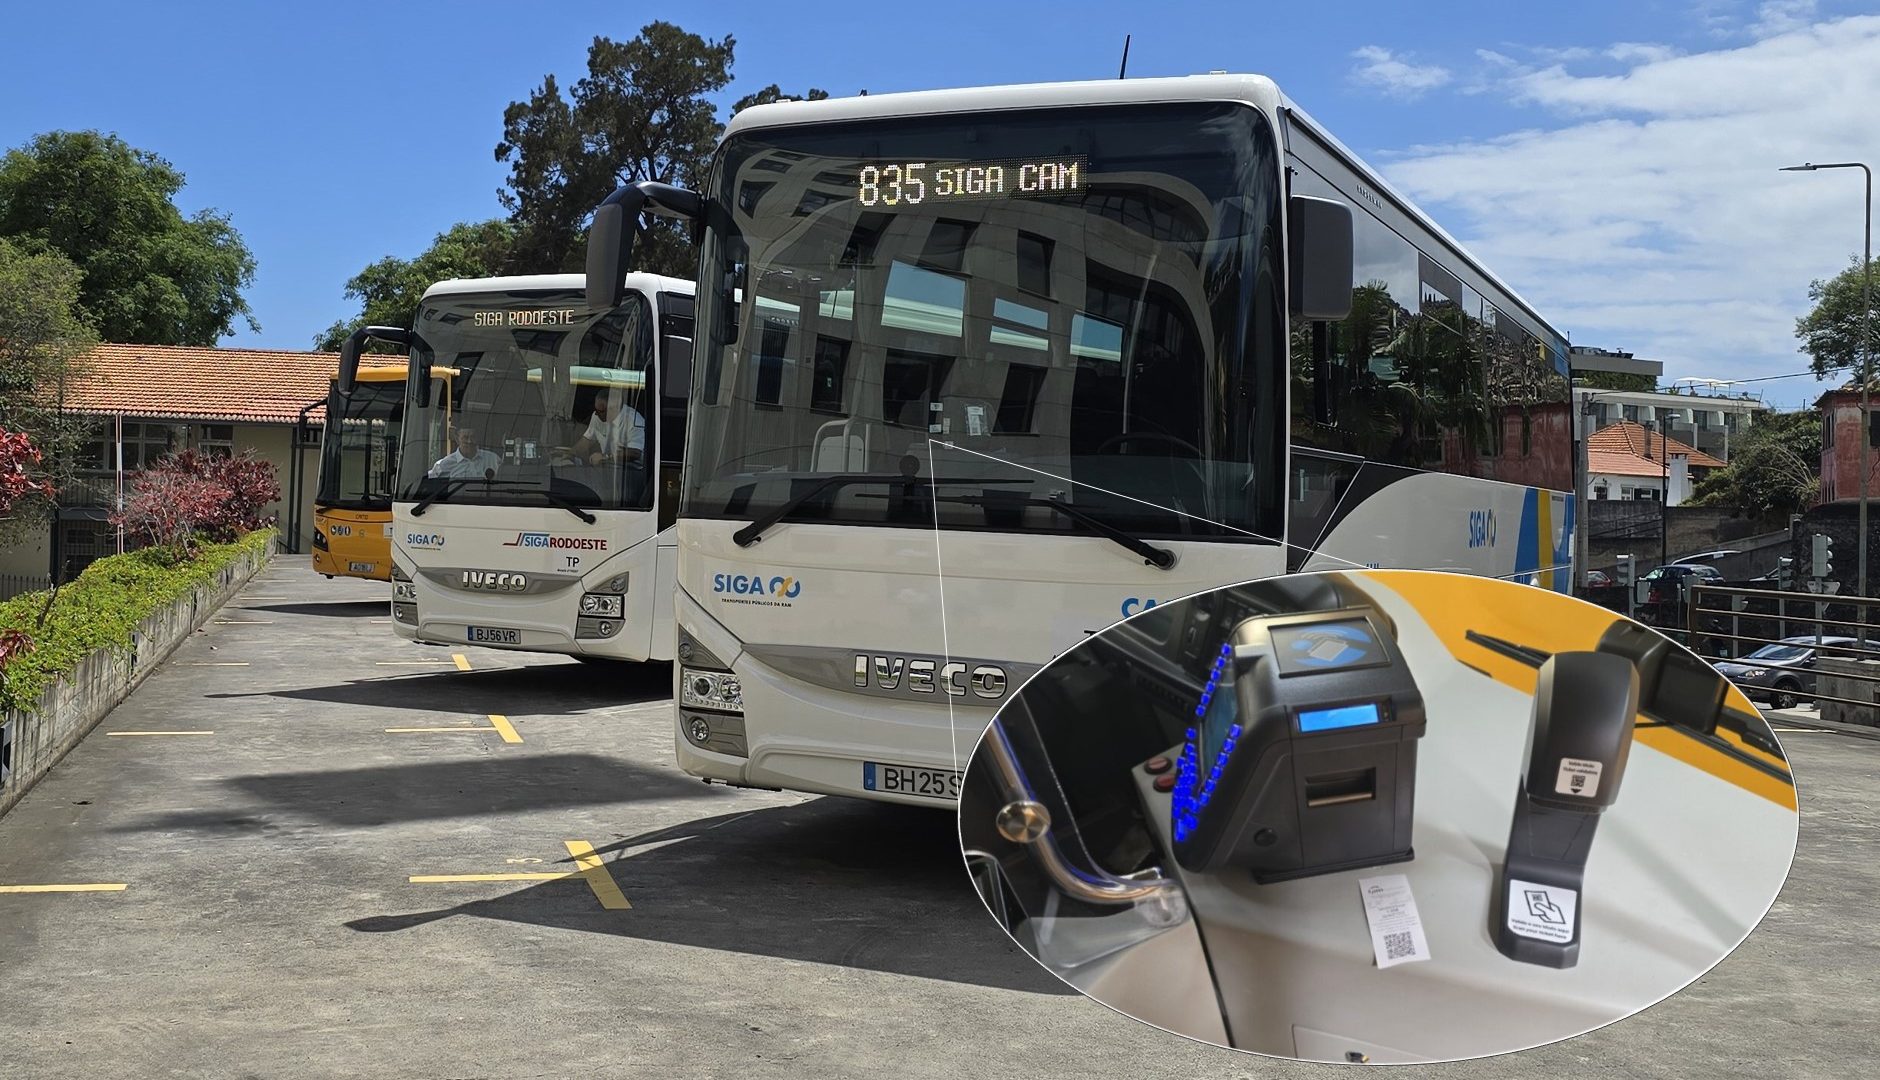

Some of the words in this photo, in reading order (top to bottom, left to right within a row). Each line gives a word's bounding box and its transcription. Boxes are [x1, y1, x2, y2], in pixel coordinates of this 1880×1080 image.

[859, 163, 926, 206] 835
[936, 166, 1003, 195] SIGA
[1019, 162, 1078, 191] CAM
[474, 311, 503, 327] SIGA
[508, 309, 575, 326] RODOESTE
[407, 533, 430, 545] SIGA
[1469, 510, 1486, 548] SIGA
[566, 556, 580, 568] TP
[462, 571, 526, 592] IVECO
[713, 573, 765, 595] SIGA
[854, 654, 1008, 699] IVECO
